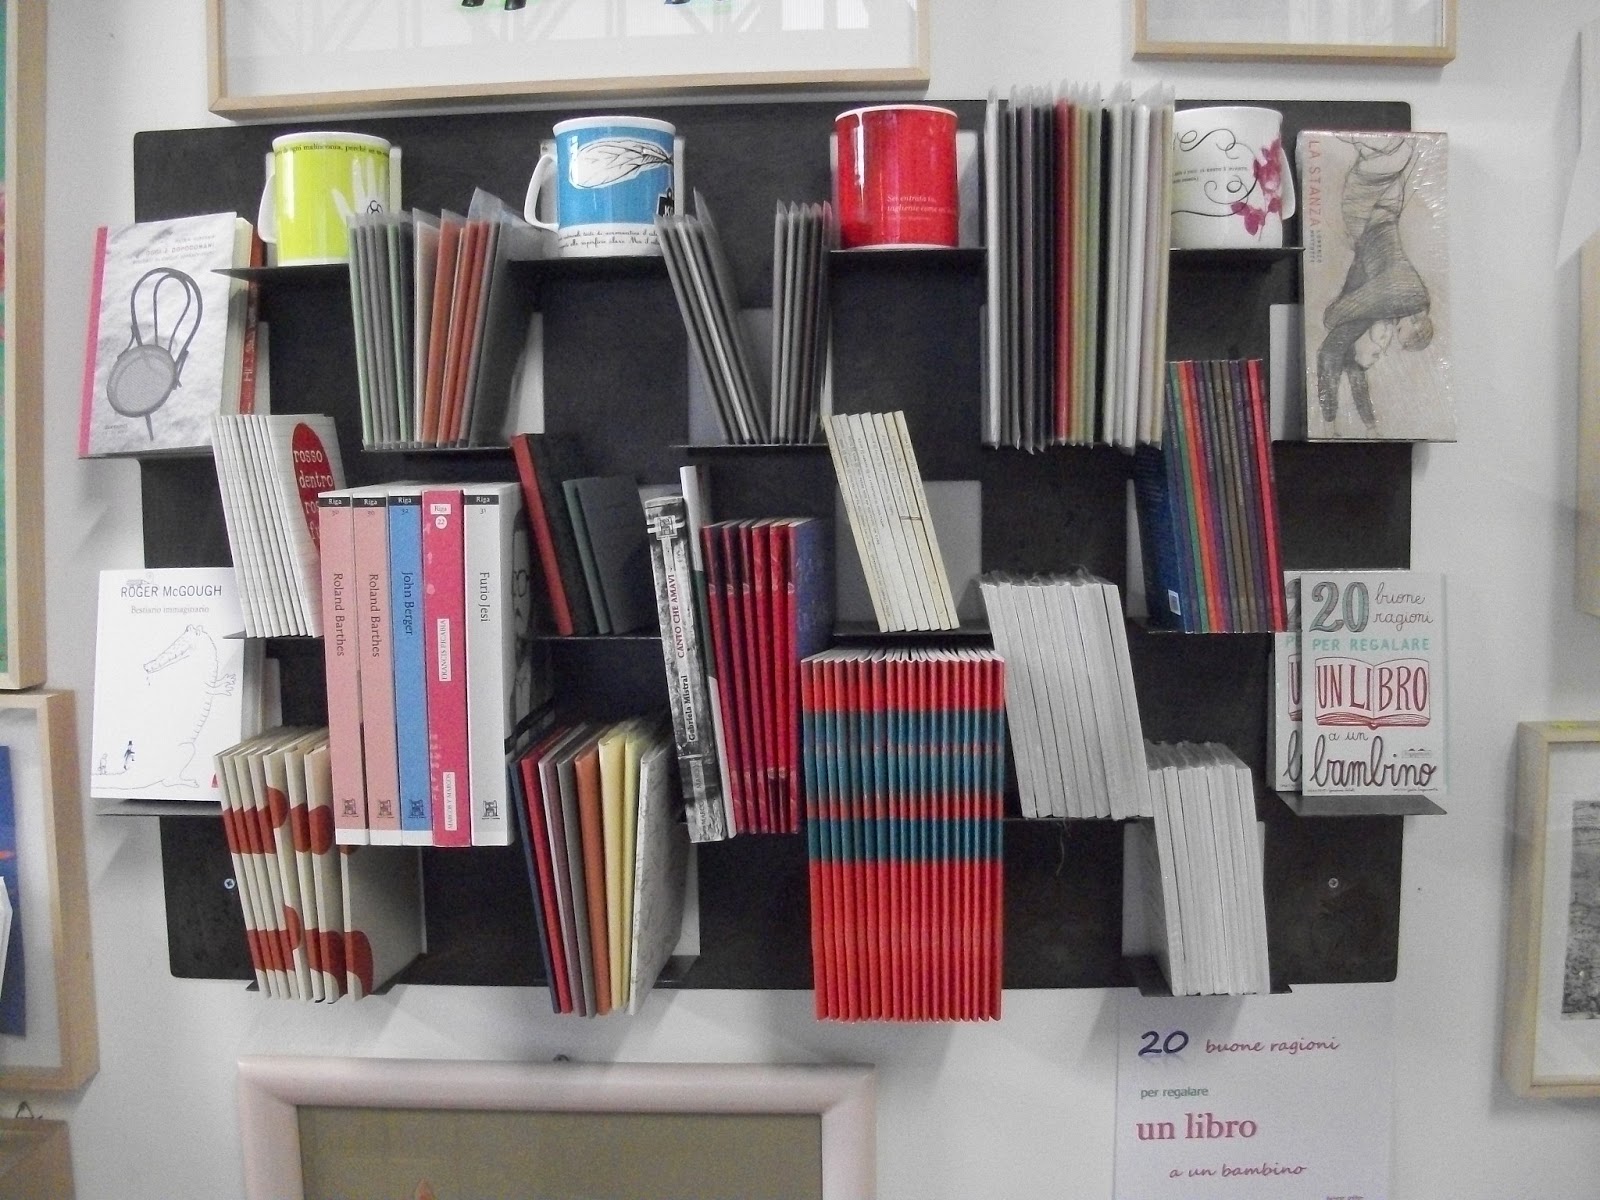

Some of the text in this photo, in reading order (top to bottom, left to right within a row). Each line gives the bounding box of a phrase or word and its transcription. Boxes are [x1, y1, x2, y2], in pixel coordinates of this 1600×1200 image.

[1308, 140, 1323, 227] LA STANZA
[293, 450, 323, 463] rosso
[299, 470, 334, 489] dentro
[328, 498, 342, 506] Riga
[363, 498, 378, 506] Riga
[397, 496, 412, 504] Riga
[434, 505, 447, 513] Riga
[476, 496, 490, 504] Riga
[120, 584, 223, 598] ROGER McGOUGH
[478, 572, 491, 622] Furio Jesi
[131, 605, 209, 615] Bestiario immaginario
[401, 571, 415, 636] John Berger
[1309, 581, 1370, 633] 20
[1375, 581, 1426, 605] buone
[333, 573, 347, 657] Roland Barthes
[369, 574, 382, 658] Roland Barthes
[667, 574, 685, 658] CANTO CHE AMAVI
[1372, 611, 1434, 632] ragioni
[1312, 638, 1340, 651] PER
[1349, 638, 1431, 651] REGALARE
[1316, 663, 1428, 713] UN LIBRO
[680, 675, 696, 741] Gabriela Mistral
[1328, 730, 1369, 741] a un
[1309, 734, 1438, 788] bambino
[1138, 1030, 1340, 1057] 20 buone ragioni
[1140, 1086, 1209, 1100] per regalare
[1136, 1112, 1257, 1140] un libro
[1169, 1162, 1307, 1179] a un bambino
